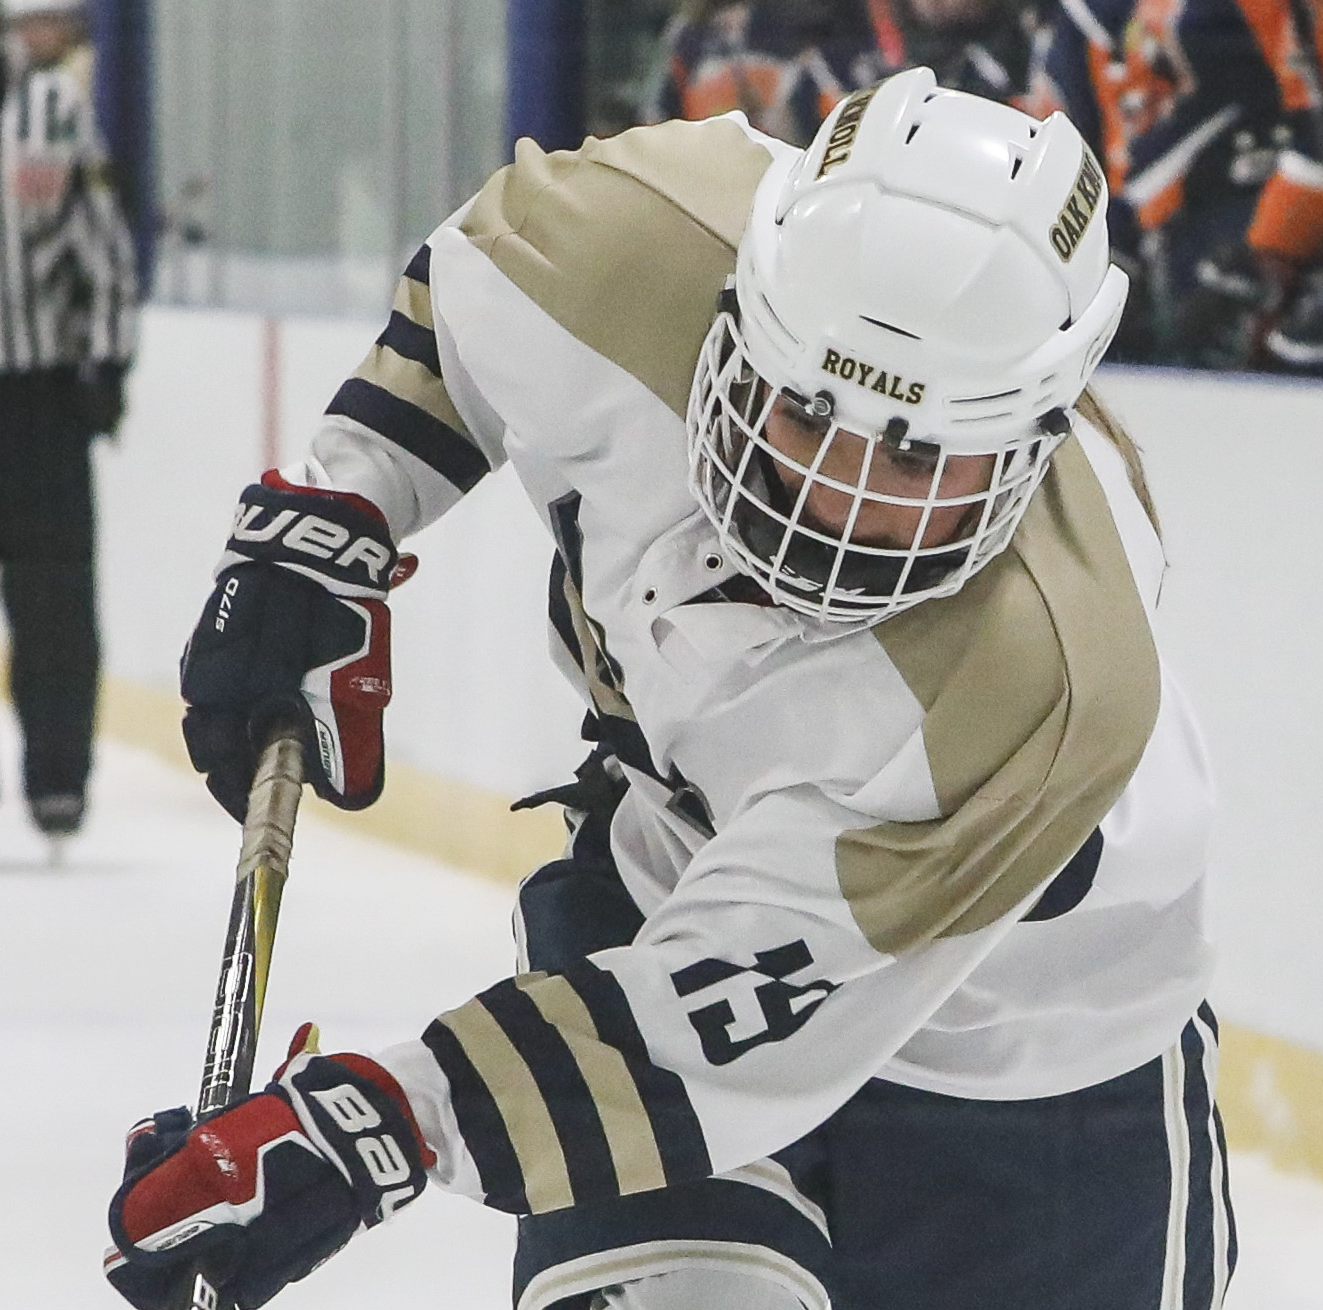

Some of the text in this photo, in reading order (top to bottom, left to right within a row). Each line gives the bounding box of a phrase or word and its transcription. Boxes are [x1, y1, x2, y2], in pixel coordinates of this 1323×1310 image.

[1051, 194, 1089, 259] OAK
[821, 348, 925, 405] ROYALS
[215, 578, 239, 632] S170
